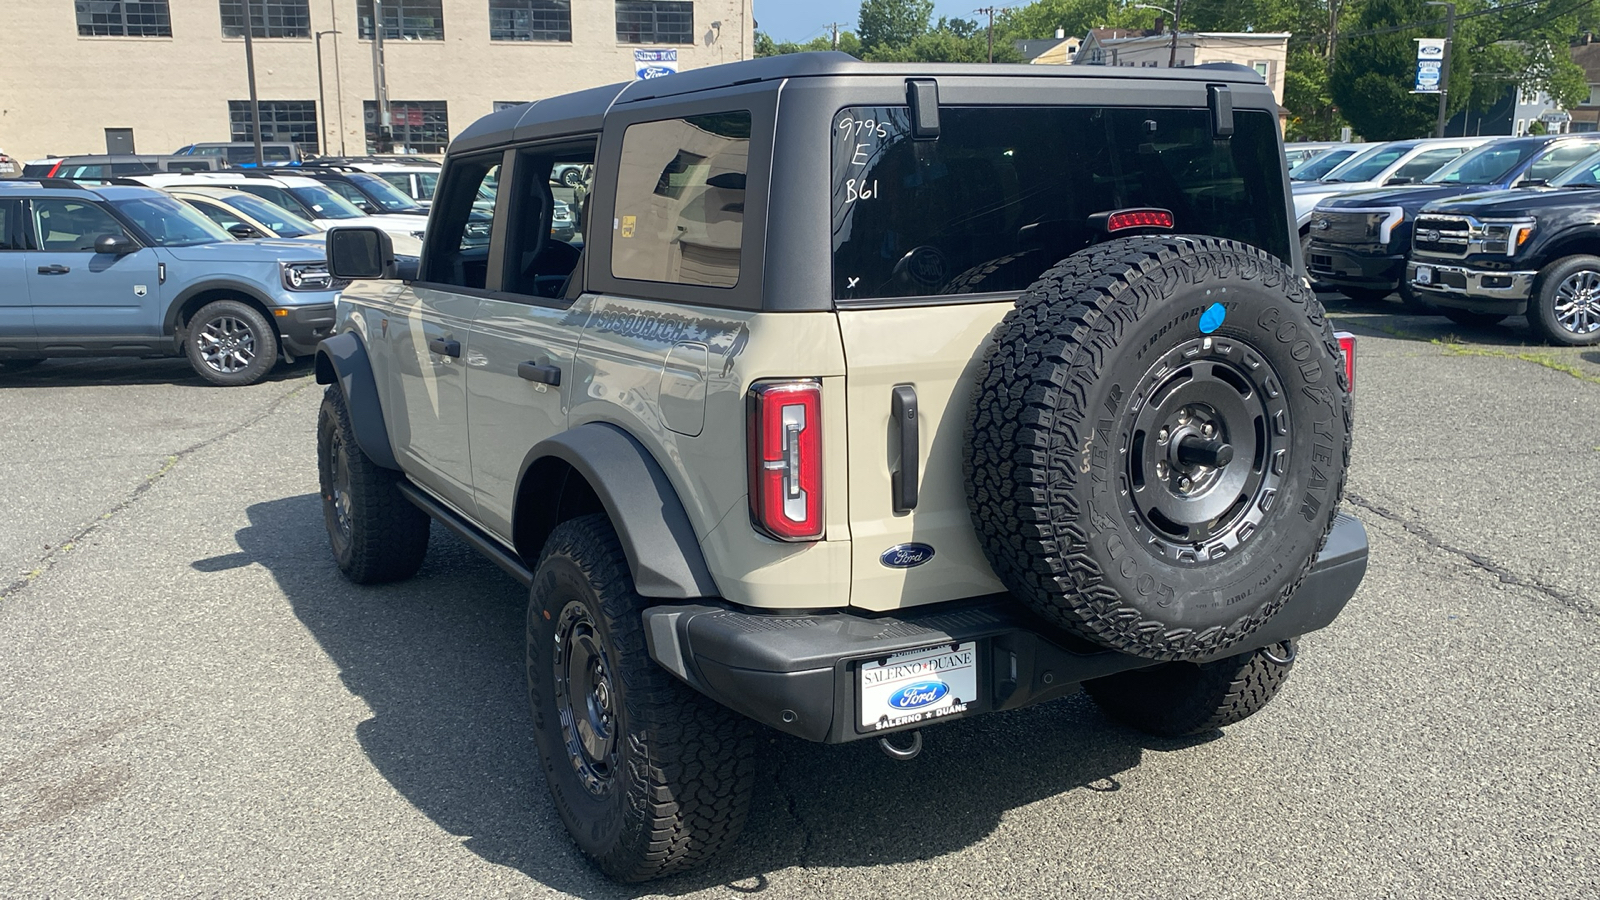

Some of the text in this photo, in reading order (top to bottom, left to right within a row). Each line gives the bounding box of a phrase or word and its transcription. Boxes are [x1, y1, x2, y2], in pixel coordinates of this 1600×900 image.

[839, 117, 892, 141] 9795
[851, 143, 871, 166] E
[845, 178, 878, 204] B61
[597, 309, 688, 341] SASQUATCH
[893, 549, 923, 564] Ford
[864, 651, 972, 685] SALERNO DUANE
[900, 685, 938, 707] Ford
[875, 703, 968, 730] SALERNO DUANE
